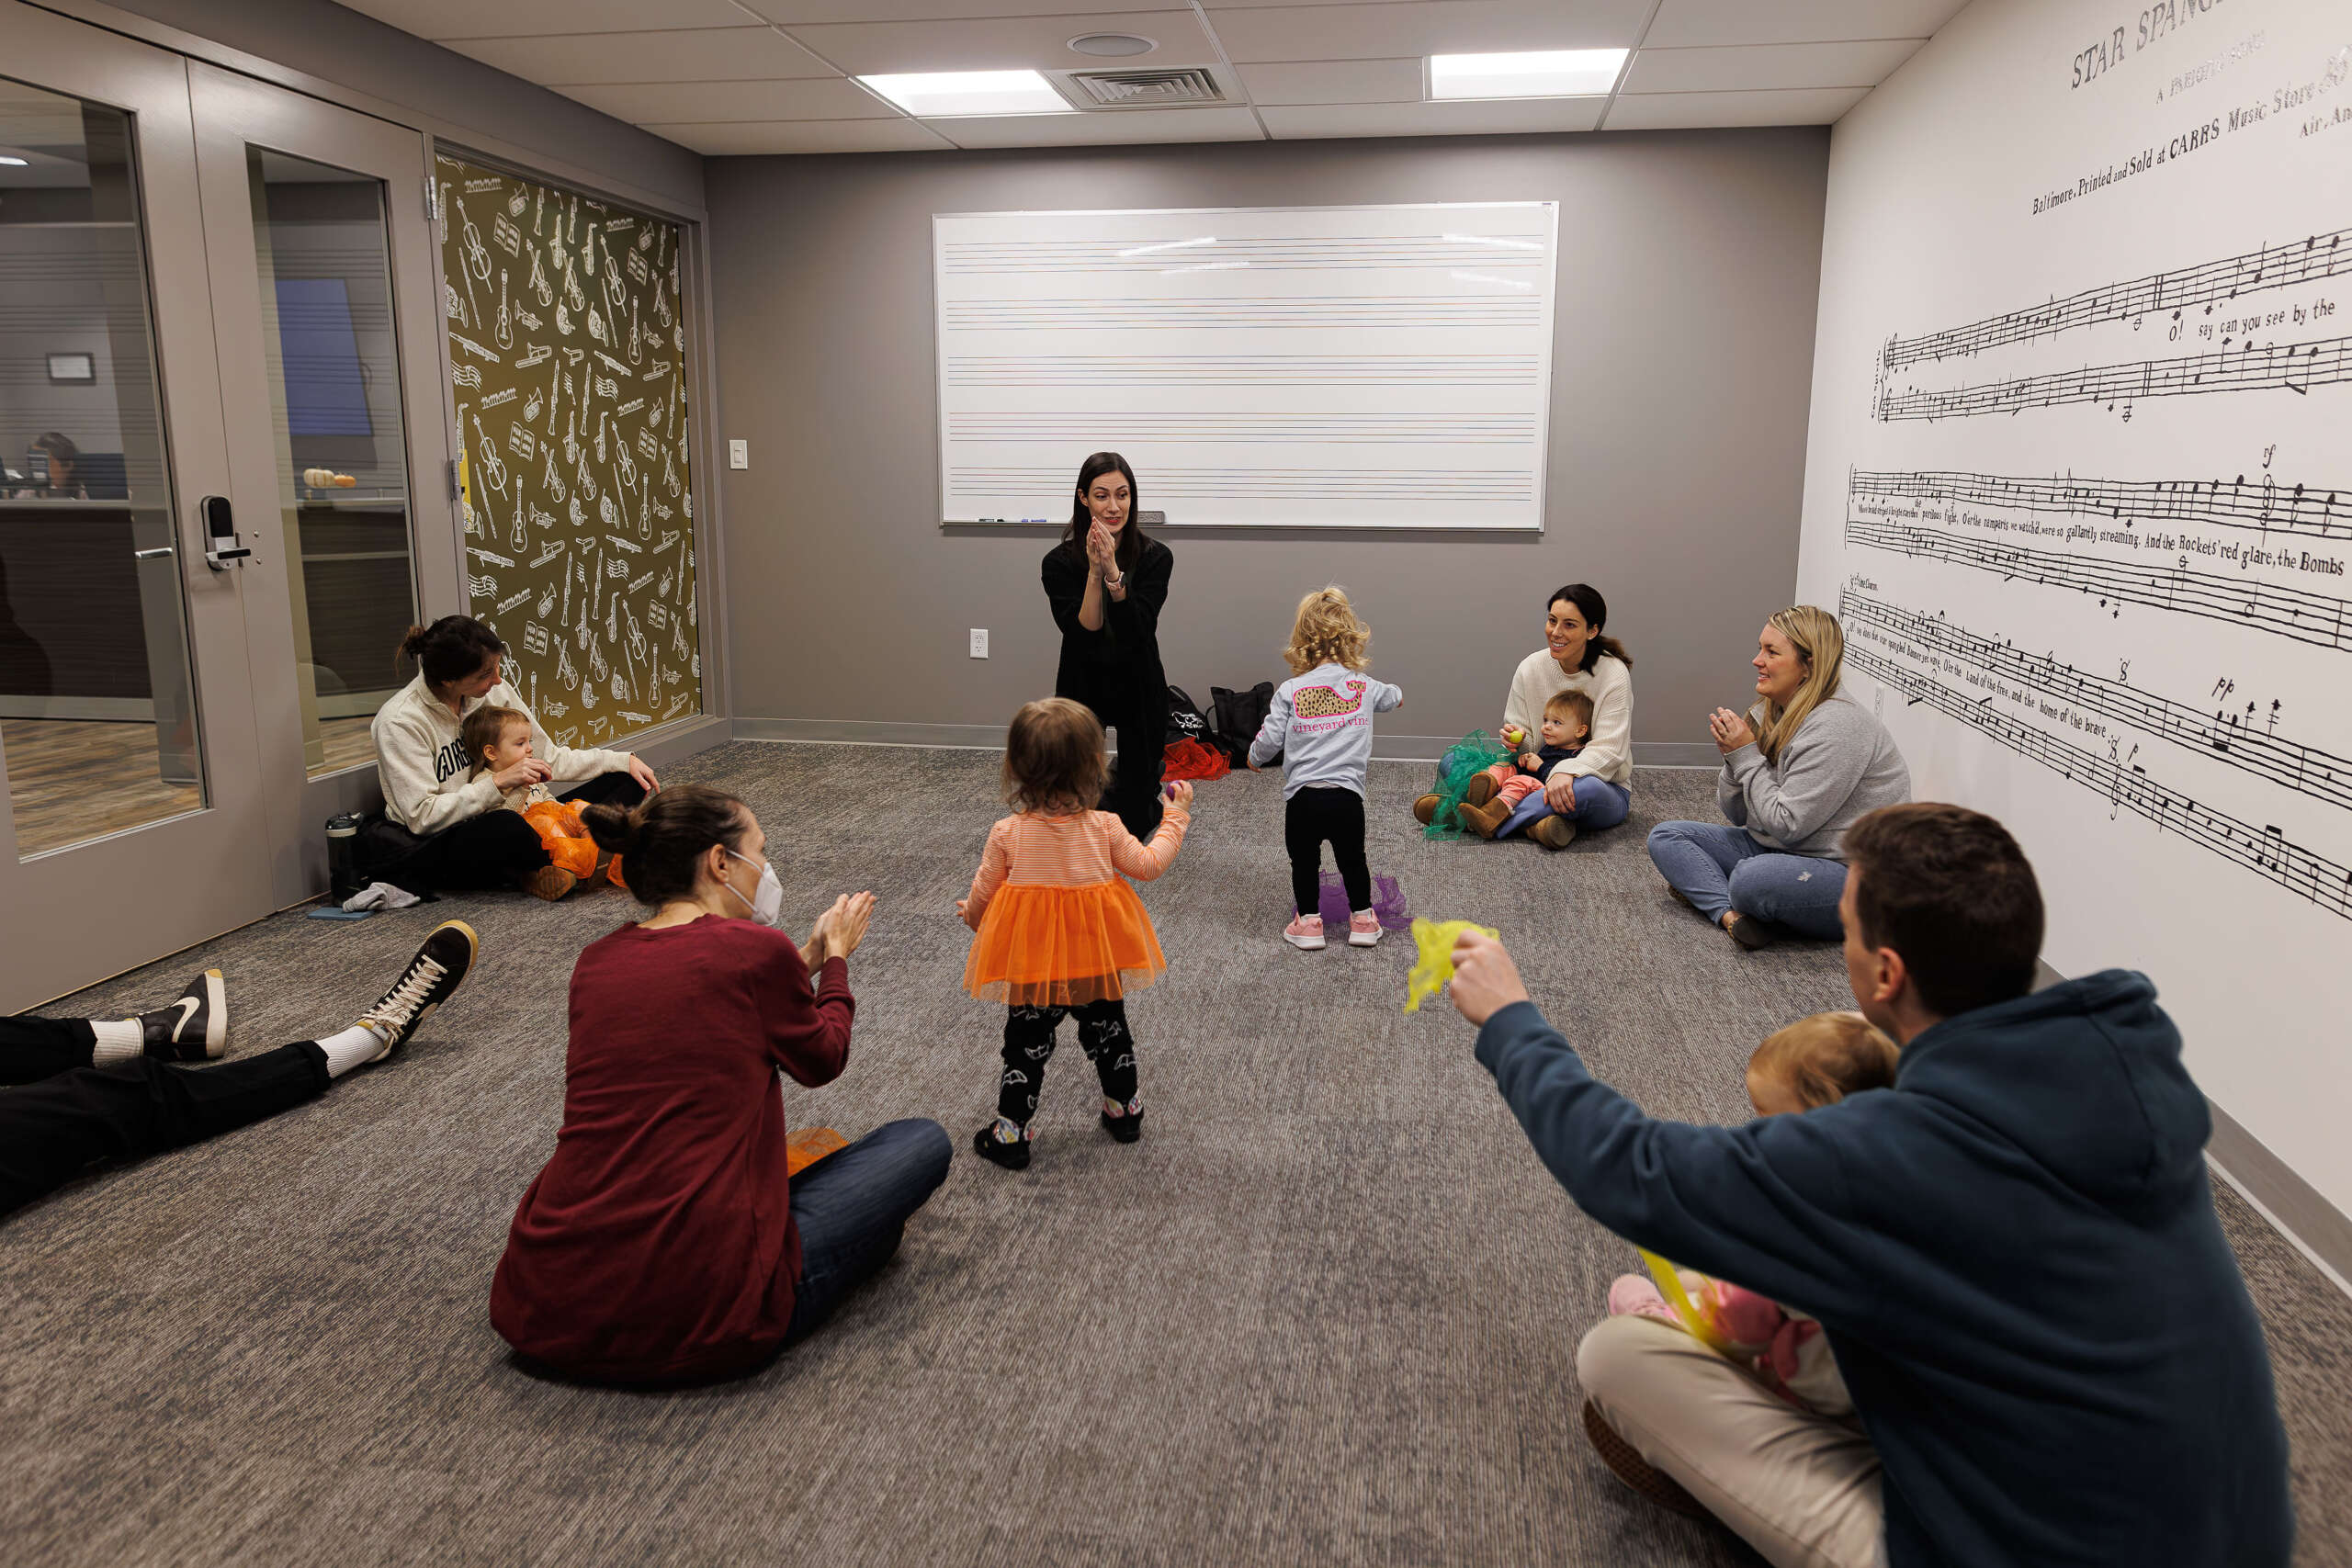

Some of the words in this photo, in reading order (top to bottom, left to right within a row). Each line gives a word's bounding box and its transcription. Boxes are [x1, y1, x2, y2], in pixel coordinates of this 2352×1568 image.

[2071, 26, 2125, 90] STAR
[2136, 0, 2223, 51] SPAN
[2331, 106, 2352, 125] An
[2078, 165, 2112, 197] Printed
[2113, 162, 2128, 182] and
[2129, 148, 2153, 175] Sold
[2156, 145, 2166, 165] at
[2169, 118, 2220, 160] CARRS
[2227, 100, 2267, 132] Music
[2169, 319, 2184, 342] O!
[2199, 323, 2213, 341] say
[2220, 319, 2237, 333] can
[2242, 315, 2260, 334] you
[2266, 310, 2285, 326] see
[2292, 304, 2306, 326] by
[2312, 299, 2335, 320] the
[2041, 526, 2055, 536] were
[2056, 528, 2064, 536] so
[2066, 525, 2098, 543] gallantly
[2144, 532, 2162, 548] And
[2163, 535, 2176, 550] the
[2221, 542, 2239, 560] red
[2242, 545, 2277, 570] glare,
[2278, 548, 2296, 569] the
[2300, 551, 2345, 576] Bombs
[1292, 717, 1346, 734] vineyard
[1966, 671, 1980, 685] Land
[1980, 674, 1987, 688] of
[1987, 678, 1996, 692] the
[2011, 689, 2022, 703] and
[2024, 694, 2035, 707] the
[2040, 699, 2058, 719] home
[2060, 707, 2069, 723] of
[2071, 712, 2083, 729] the
[2085, 717, 2107, 738] brave
